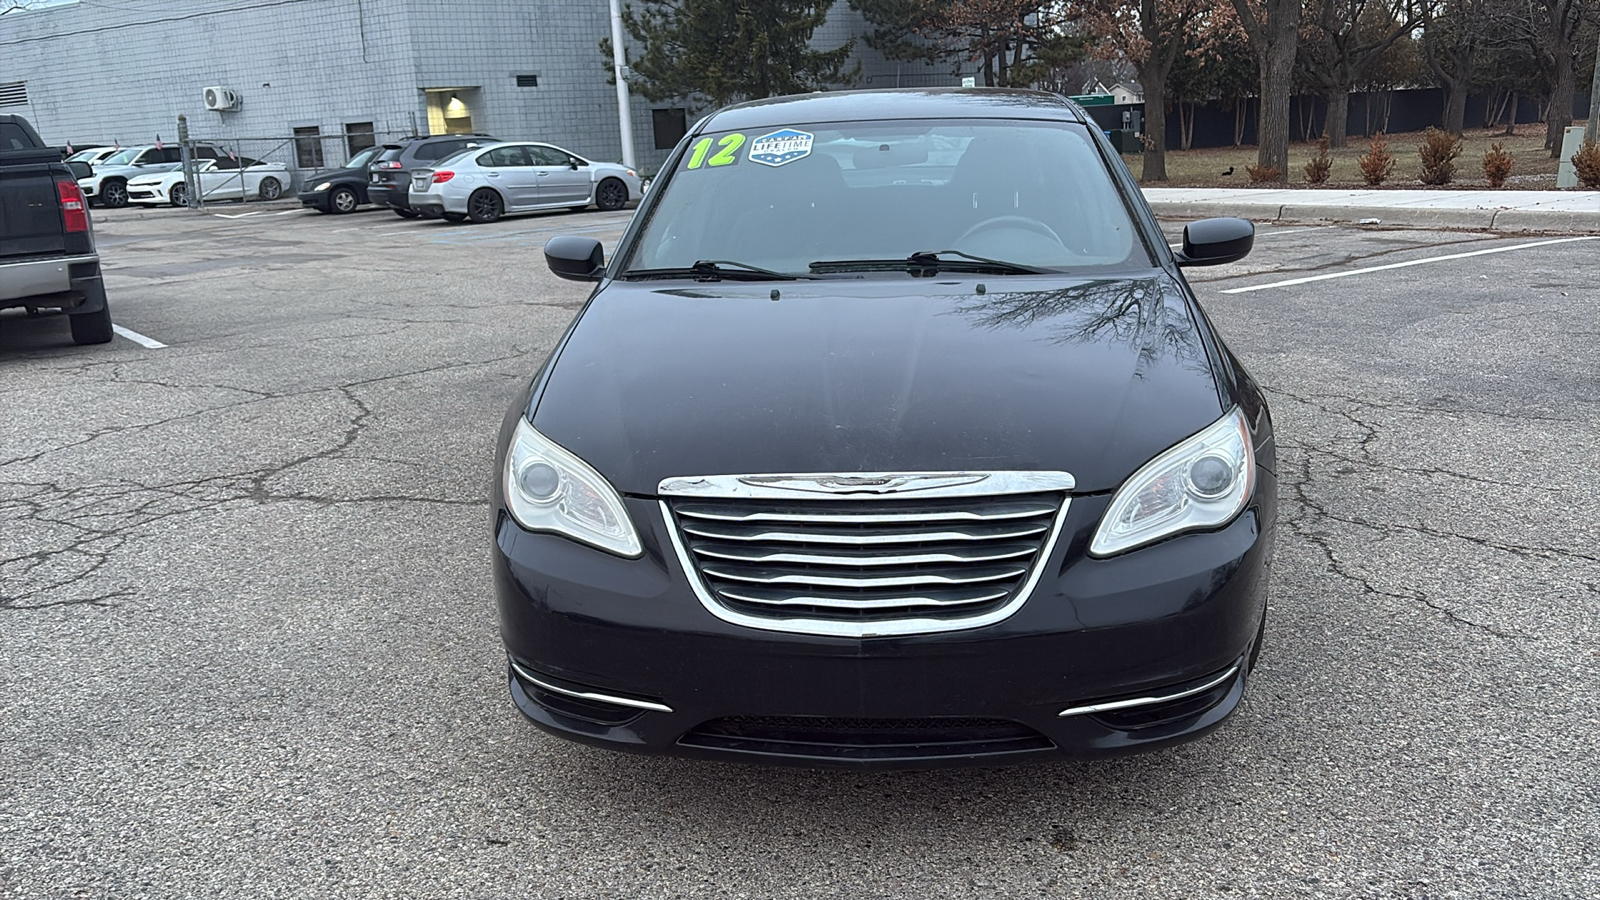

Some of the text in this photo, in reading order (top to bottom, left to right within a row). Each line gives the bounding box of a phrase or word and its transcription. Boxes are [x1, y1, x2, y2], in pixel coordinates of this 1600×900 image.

[760, 135, 806, 143] CARFAX
[687, 133, 746, 169] 12
[753, 140, 811, 151] LIFETIME
